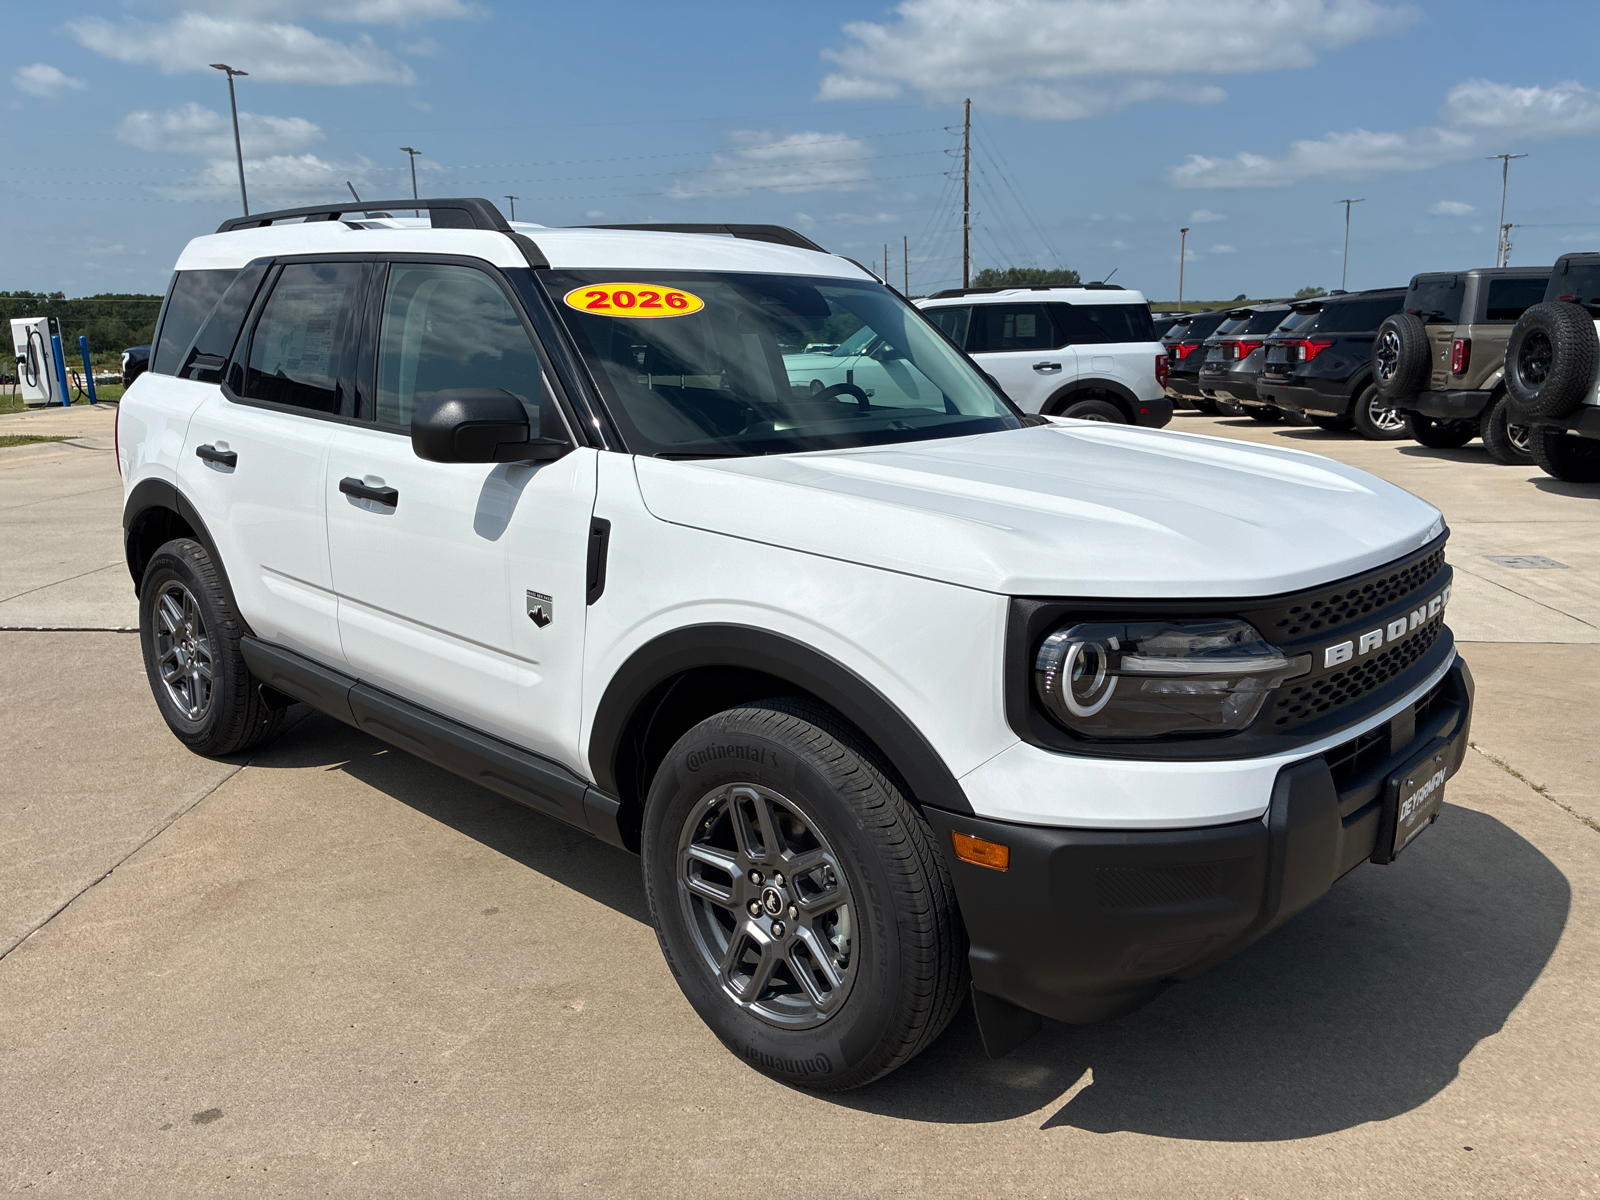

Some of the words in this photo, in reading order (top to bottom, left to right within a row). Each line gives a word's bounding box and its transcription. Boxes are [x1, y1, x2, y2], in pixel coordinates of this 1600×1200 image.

[585, 291, 689, 309] 2026
[685, 742, 767, 772] Continental
[1399, 767, 1447, 822] DEYARMAN
[745, 1043, 833, 1078] Continental
